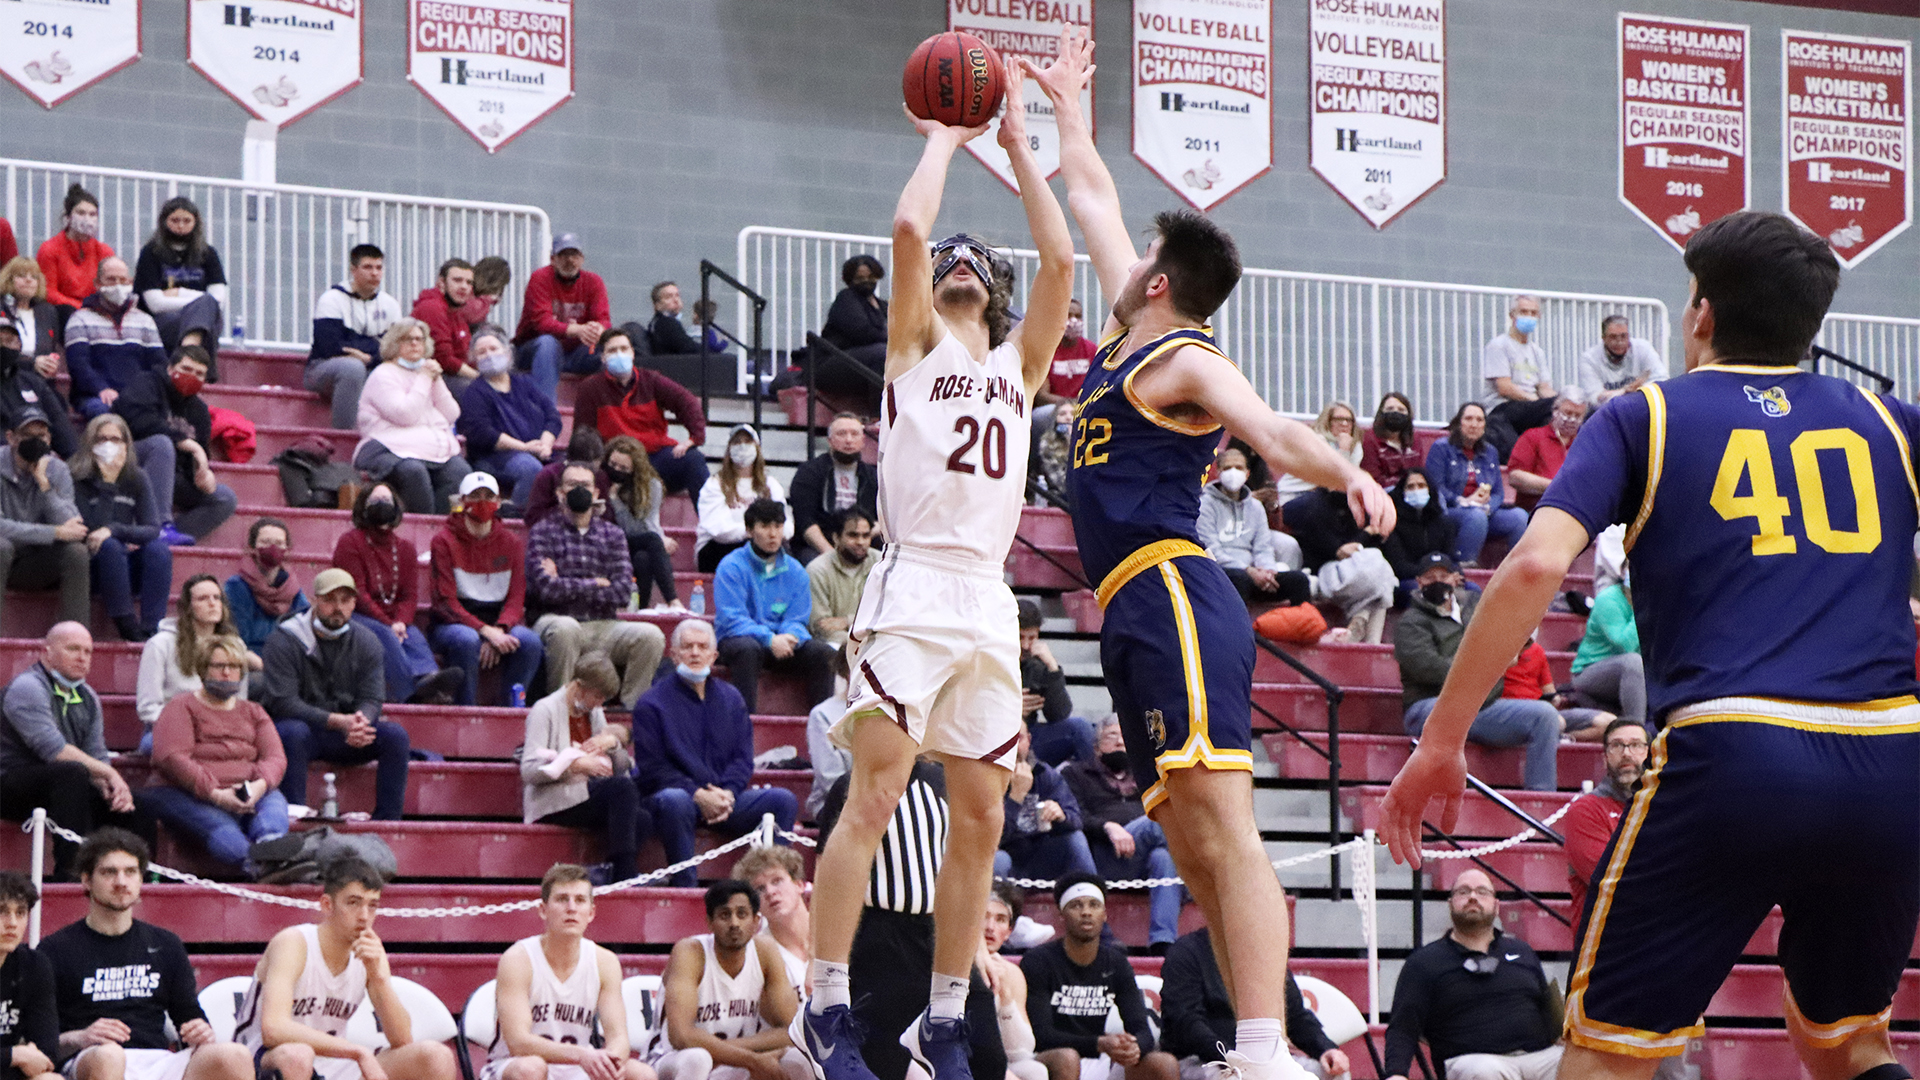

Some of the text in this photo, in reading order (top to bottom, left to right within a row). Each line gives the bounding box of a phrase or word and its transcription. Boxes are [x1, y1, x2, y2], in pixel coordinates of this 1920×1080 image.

[224, 5, 334, 31] Heartland
[420, 2, 562, 33] REGULAR SEASON
[954, 0, 1090, 26] VOLLEYBALL
[23, 20, 73, 38] 2014
[419, 20, 563, 61] CHAMPIONS
[1139, 12, 1265, 43] VOLLEYBALL
[1625, 25, 1742, 53] ROSE-HULMAN
[254, 46, 300, 62] 2014
[1140, 44, 1265, 69] TOURNAMENT
[1315, 31, 1441, 63] VOLLEYBALL
[1789, 42, 1903, 68] ROSE-HULMAN
[440, 57, 545, 86] Heartland
[968, 48, 988, 115] Wilson
[1140, 58, 1265, 94] CHAMPIONS
[1316, 65, 1440, 93] REGULAR SEASON
[1642, 59, 1726, 86] WOMEN'S
[1317, 85, 1438, 119] CHAMPIONS
[1625, 78, 1742, 106] BASKETBALL
[1805, 76, 1888, 101] WOMEN'S
[1160, 91, 1250, 114] Heartland
[1630, 105, 1740, 125] REGULAR SEASON
[1789, 94, 1904, 122] BASKETBALL
[1336, 127, 1422, 152] Heartland
[1630, 120, 1740, 148] CHAMPIONS
[1793, 121, 1901, 140] REGULAR SEASON
[1185, 137, 1220, 152] 2011
[1644, 146, 1729, 168] Heartland
[1793, 135, 1902, 162] CHAMPIONS
[1365, 168, 1392, 184] 2011
[1808, 161, 1890, 183] Heartland
[1666, 181, 1703, 198] 2016
[1830, 195, 1866, 212] 2017
[945, 415, 1006, 481] 20
[1074, 418, 1112, 470] 22
[1709, 428, 1882, 556] 40
